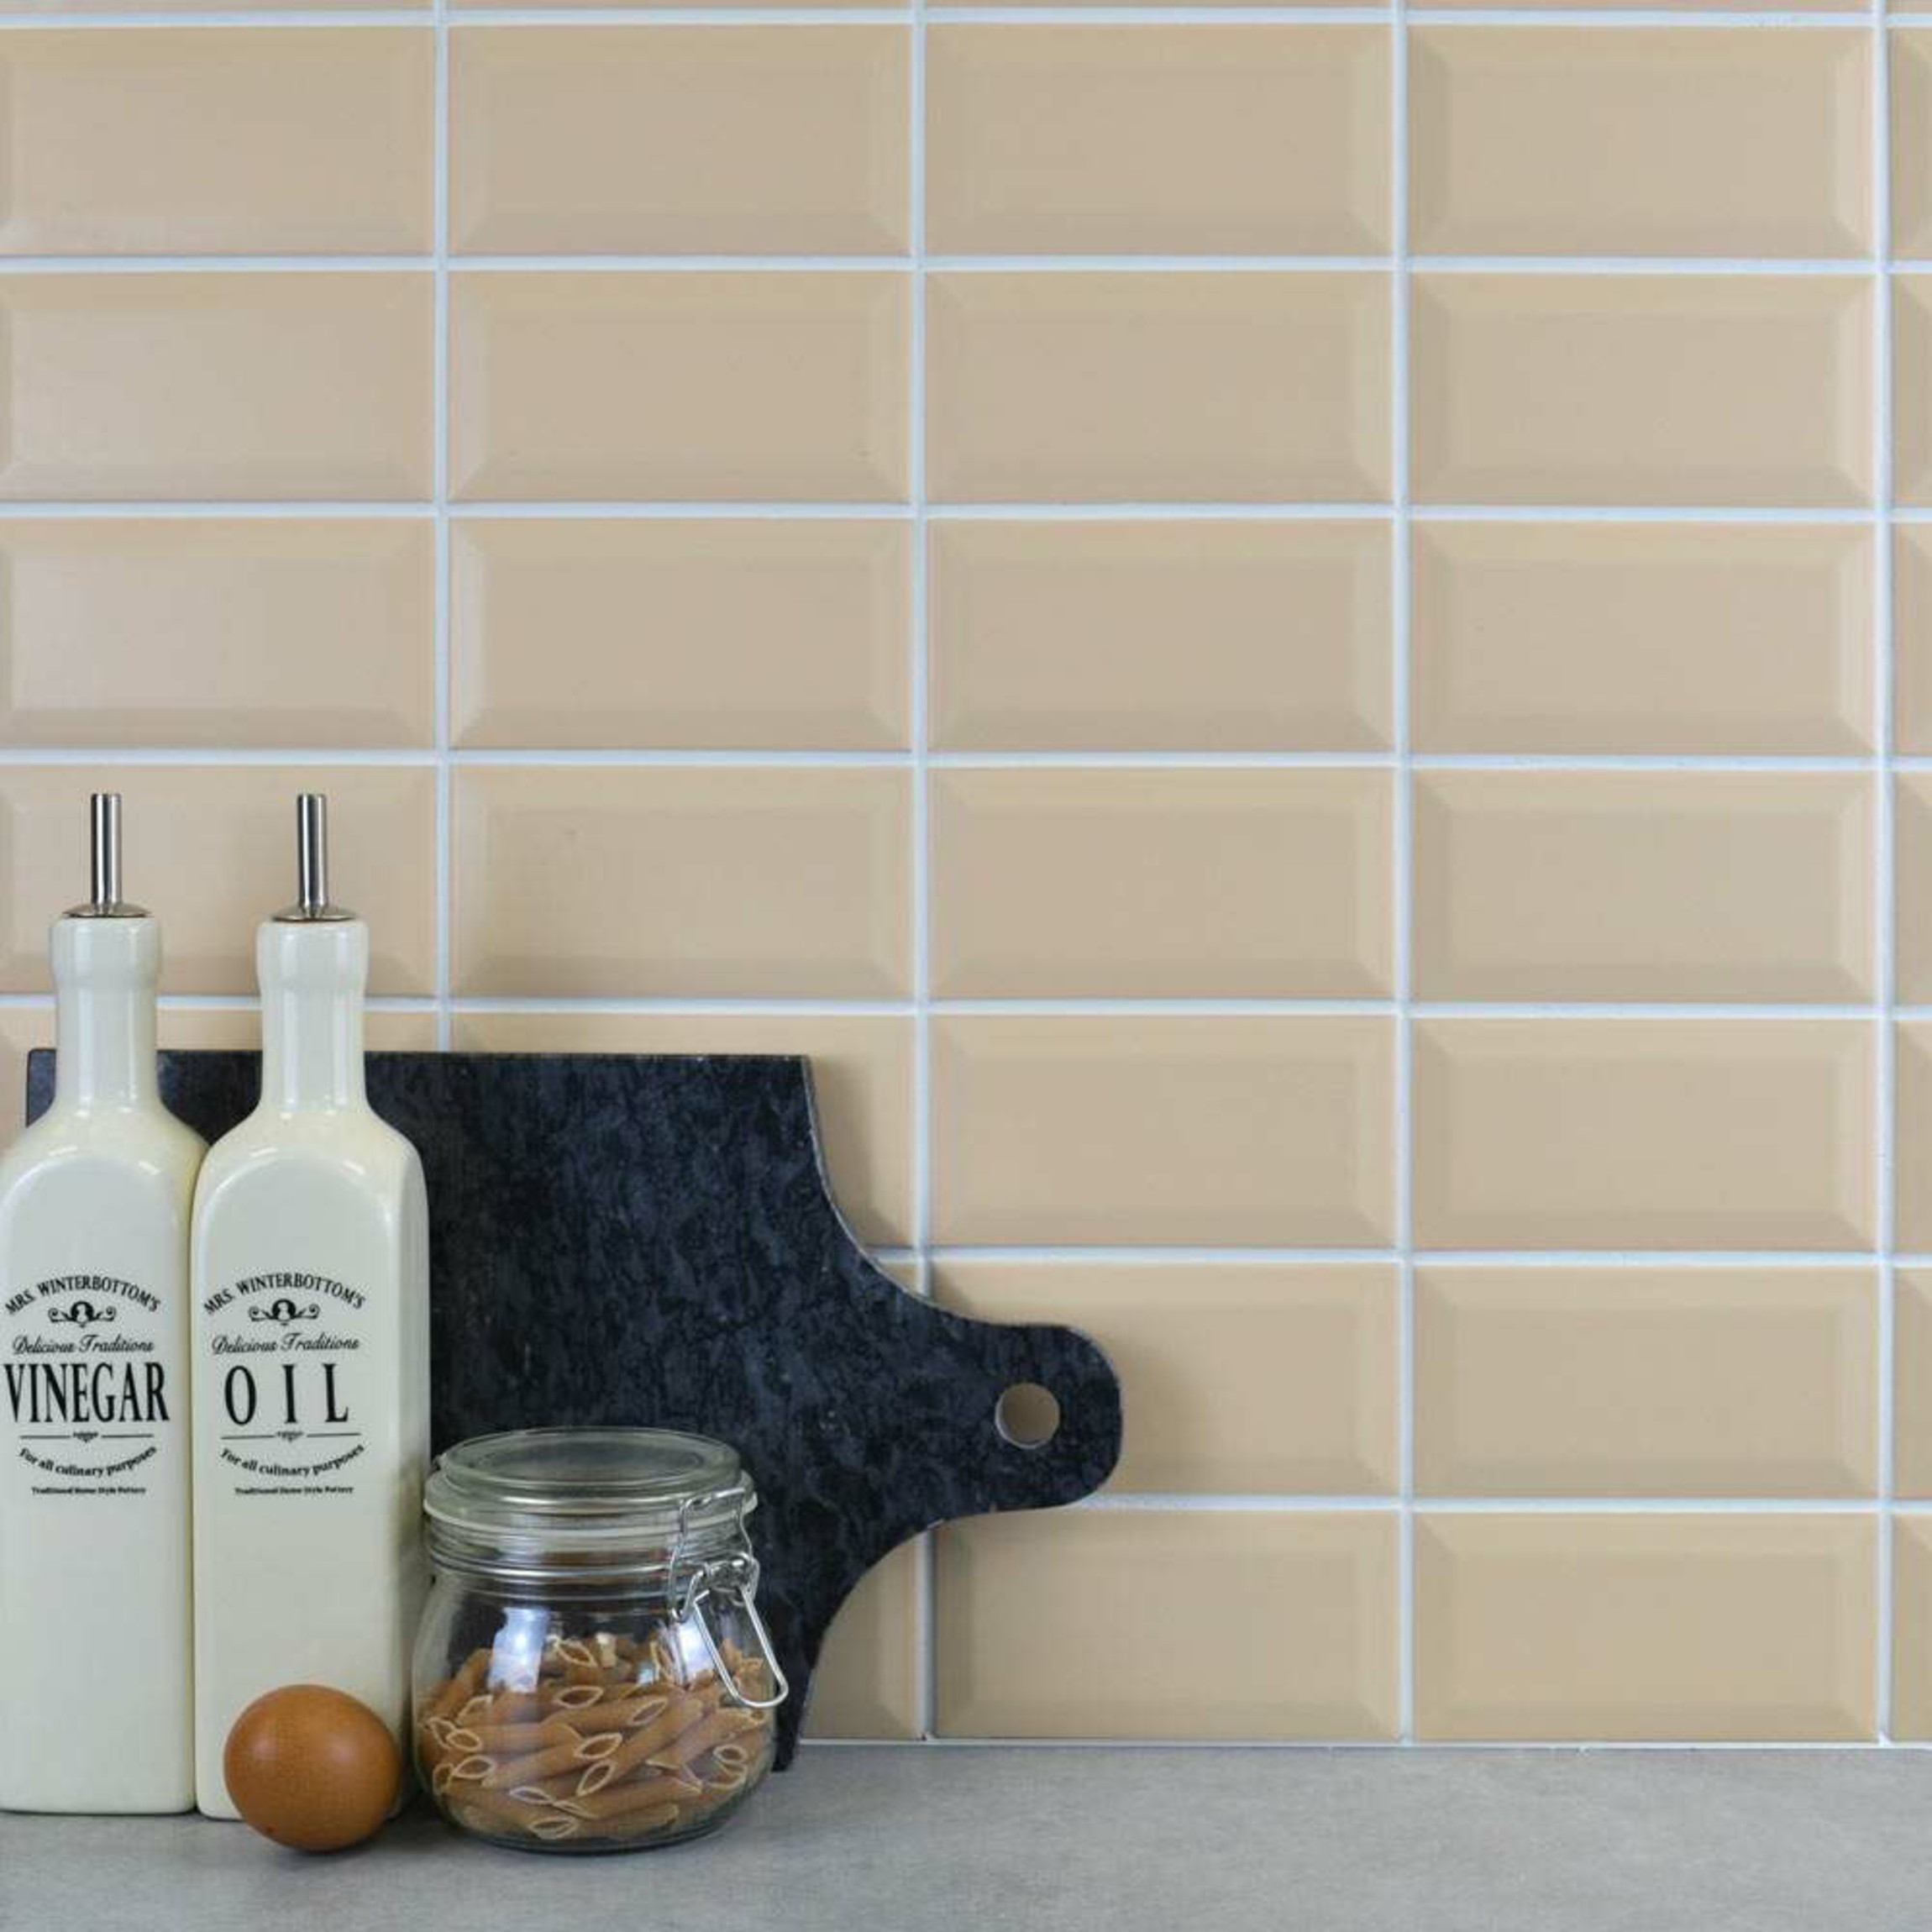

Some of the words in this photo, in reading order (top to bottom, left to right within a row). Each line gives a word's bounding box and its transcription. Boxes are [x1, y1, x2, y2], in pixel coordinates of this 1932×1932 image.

[37, 1274, 161, 1312] WINTERBOTTOM'S
[236, 1273, 365, 1310] WINTERBOTTOM'S
[13, 1334, 76, 1355] Delicious
[79, 1333, 155, 1353] Traditions
[212, 1334, 277, 1355] Delicious
[281, 1331, 360, 1352] Traditions
[3, 1362, 171, 1423] VINEGAR
[224, 1362, 349, 1426] OIL
[19, 1447, 38, 1464] For
[39, 1459, 55, 1471] all
[55, 1464, 104, 1478] culinary
[107, 1446, 157, 1477] purposes
[220, 1447, 241, 1465] For
[241, 1459, 258, 1471] all
[259, 1464, 310, 1478] culinary
[312, 1444, 365, 1476] purposes
